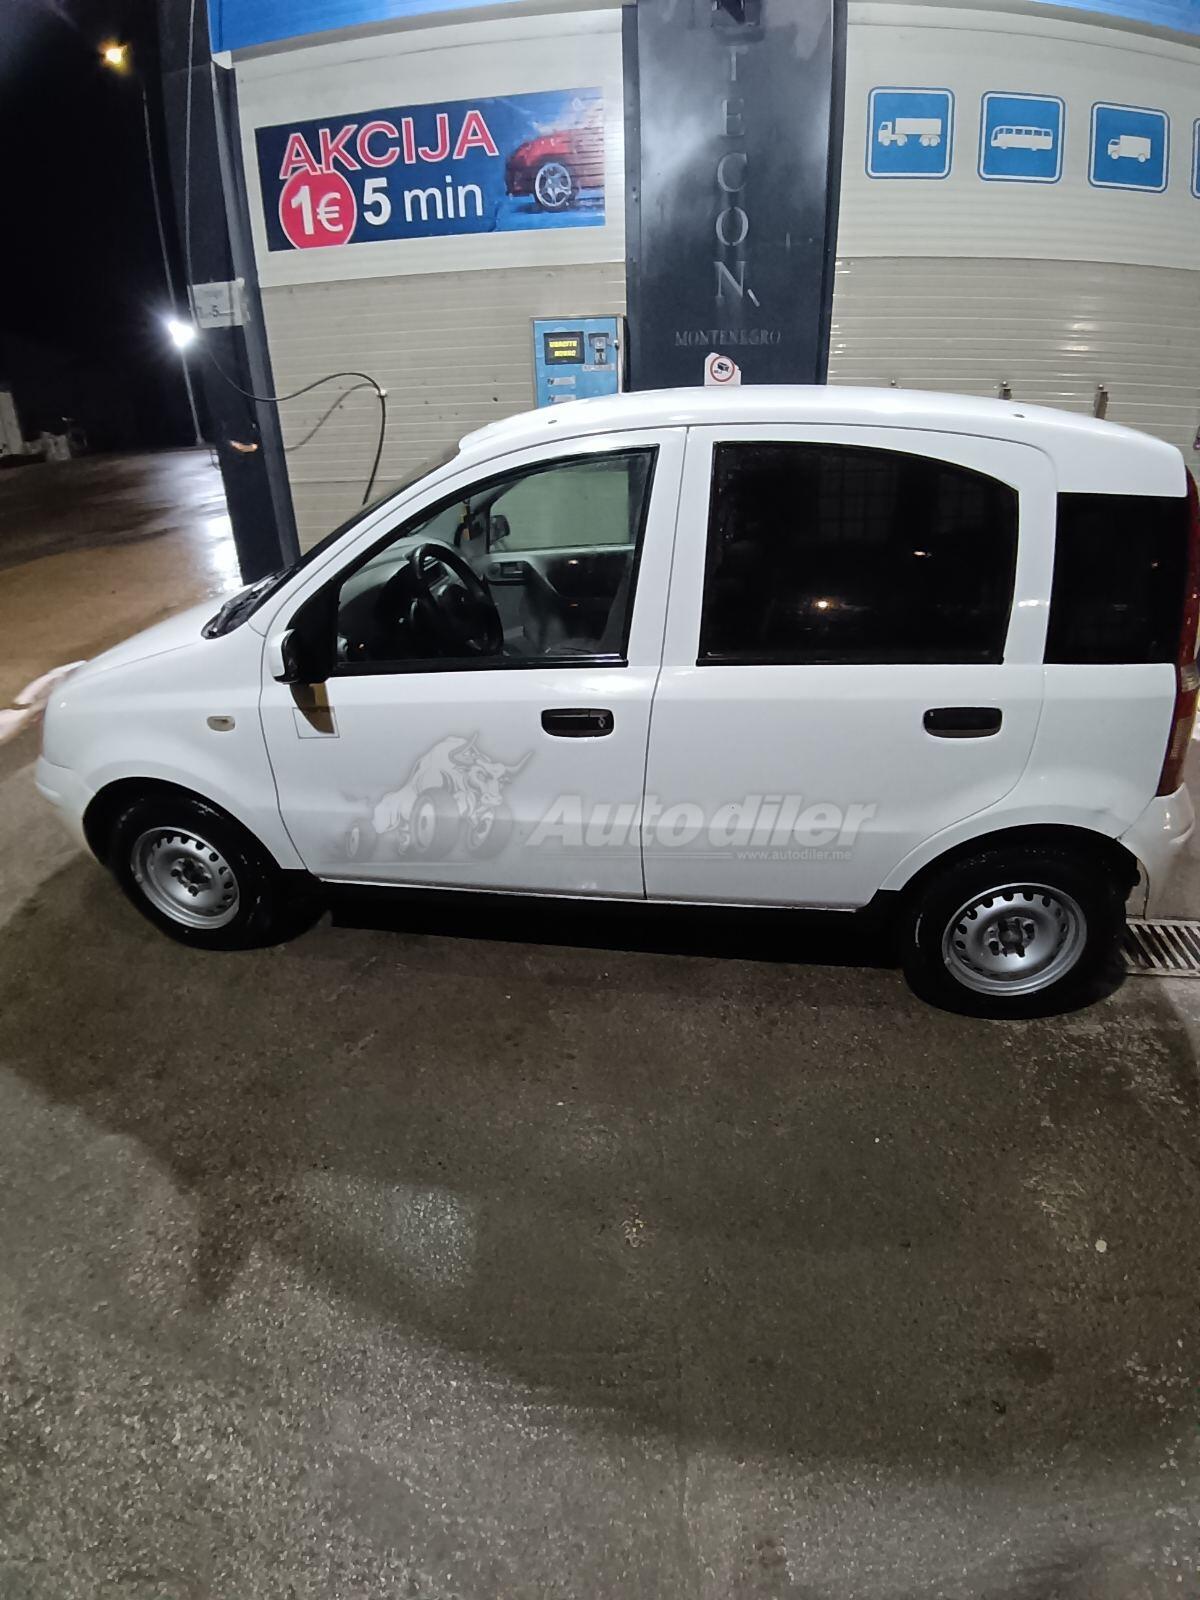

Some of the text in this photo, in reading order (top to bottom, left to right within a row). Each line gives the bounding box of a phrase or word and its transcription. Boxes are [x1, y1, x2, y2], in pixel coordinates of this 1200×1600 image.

[279, 109, 499, 180] AKCIJA
[289, 175, 484, 236] 1€ 5 min
[674, 329, 782, 347] MONTENEGRO
